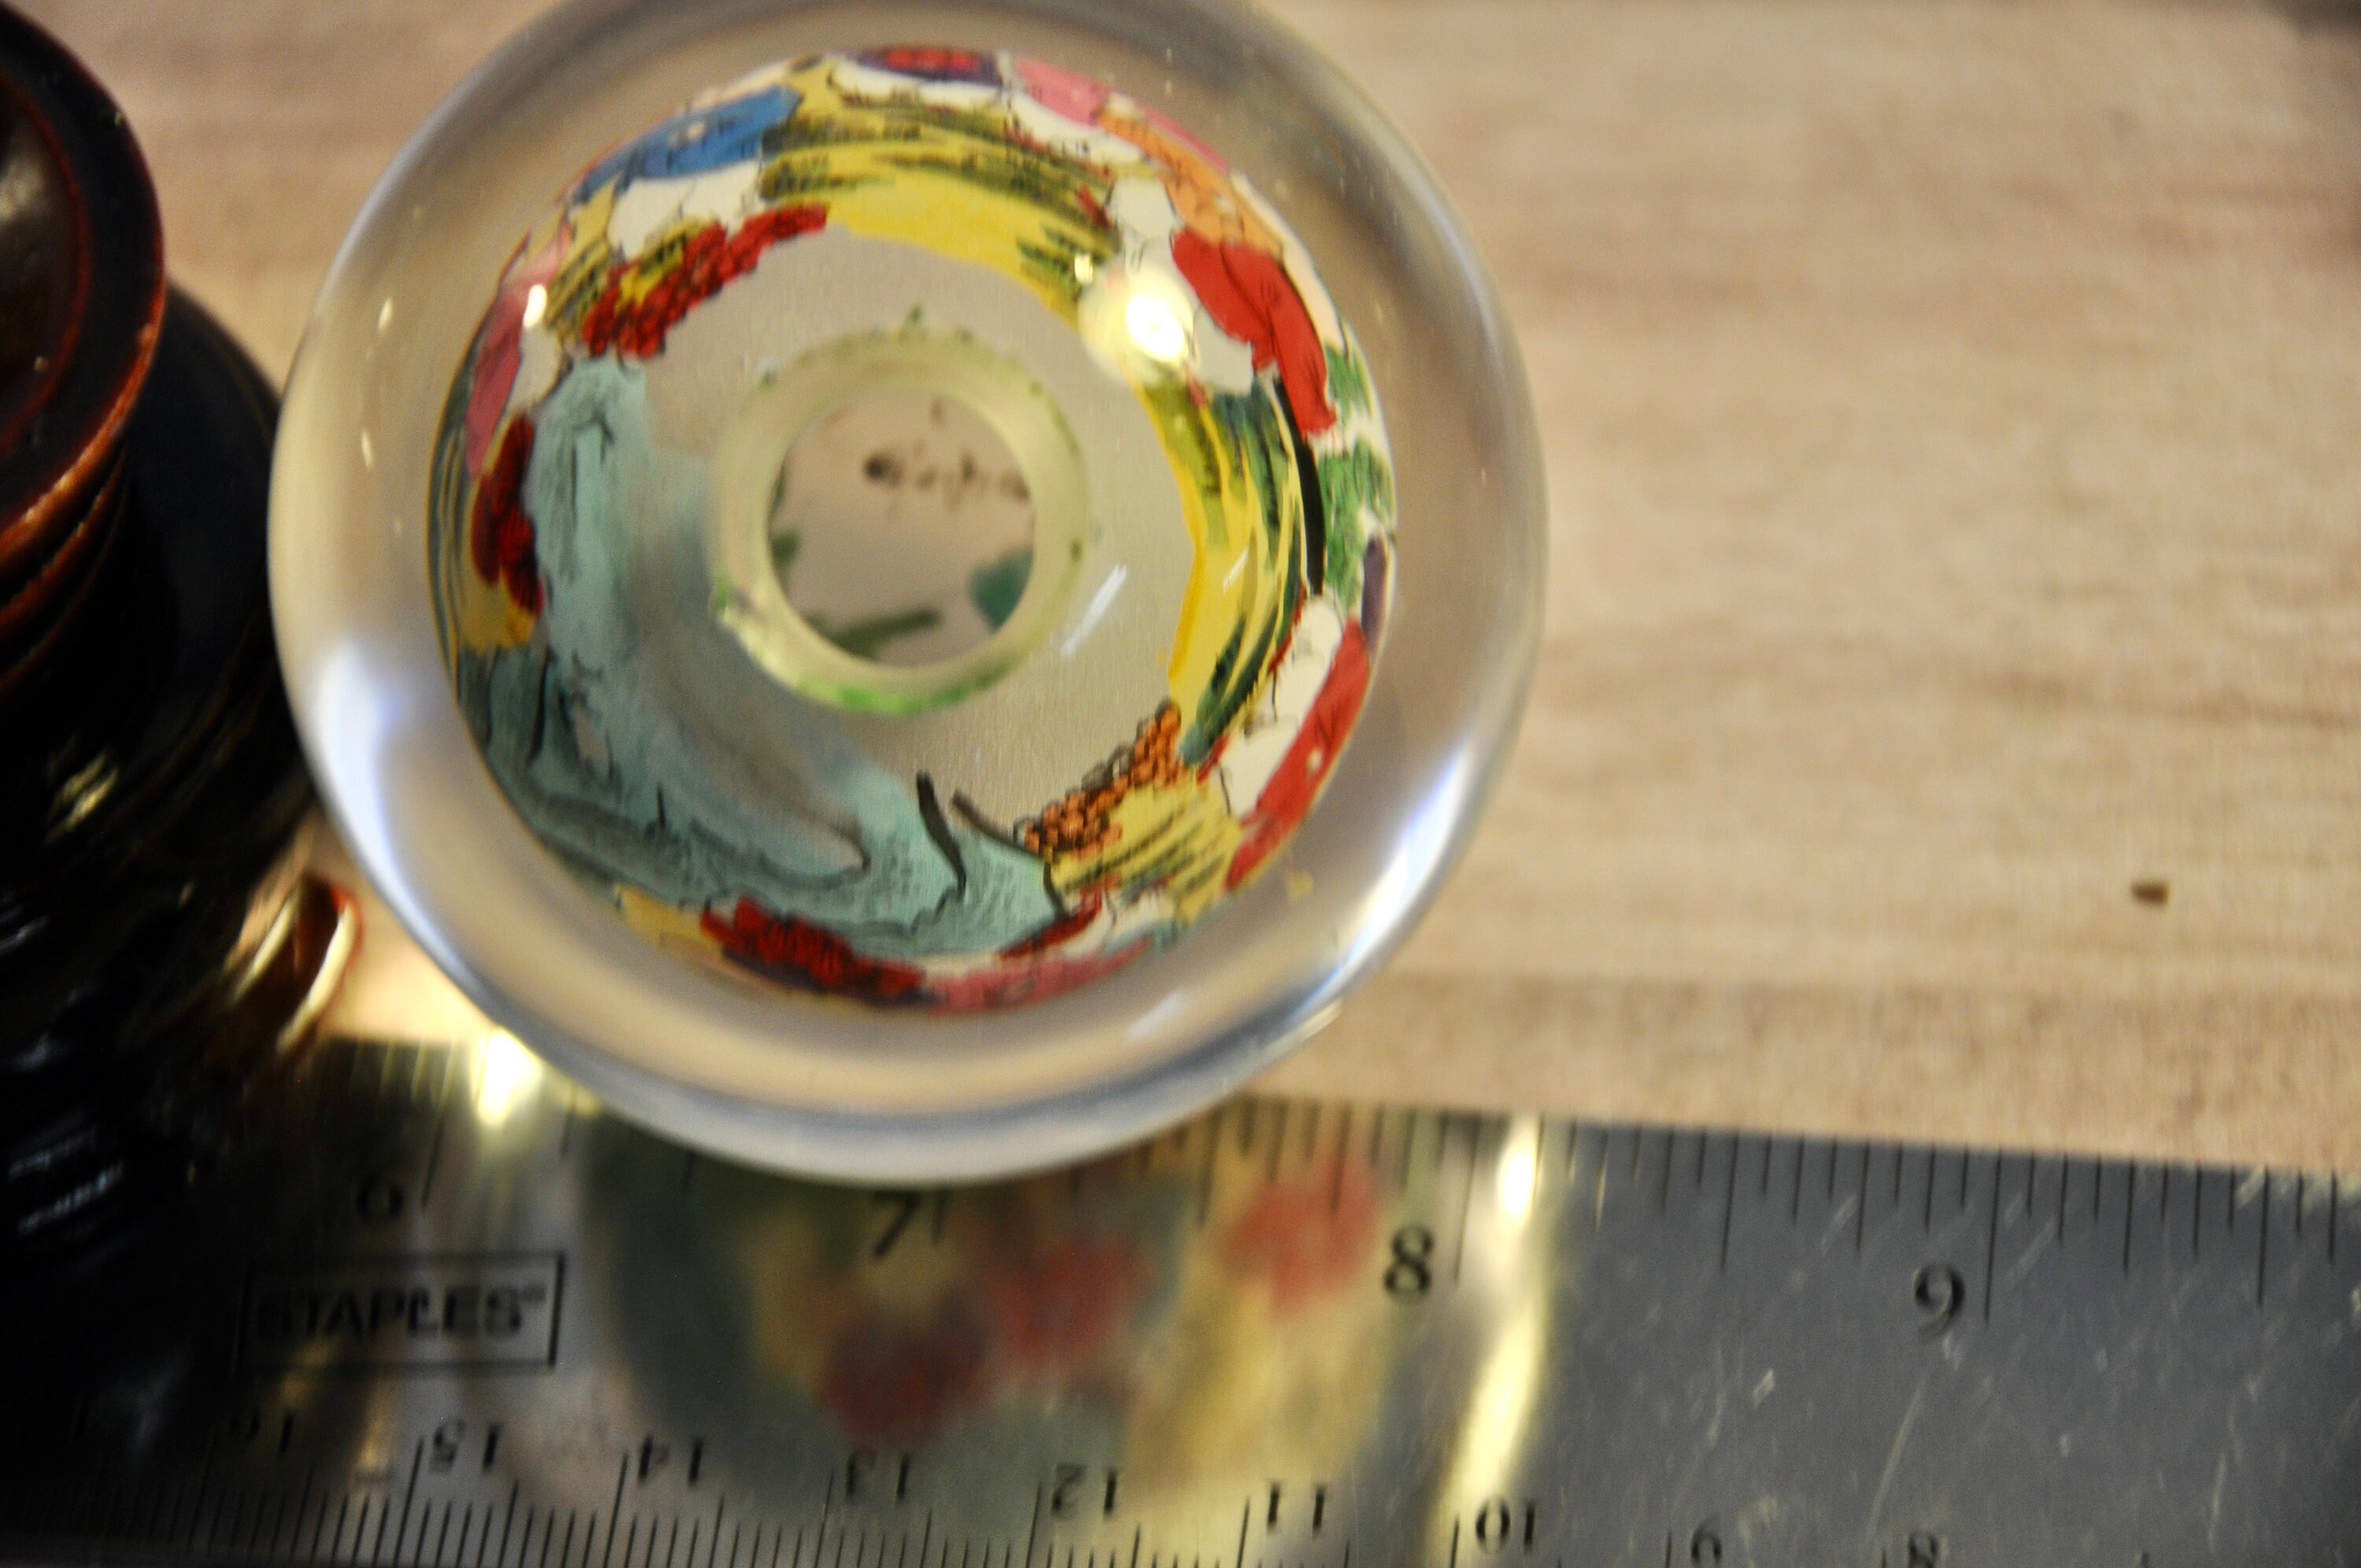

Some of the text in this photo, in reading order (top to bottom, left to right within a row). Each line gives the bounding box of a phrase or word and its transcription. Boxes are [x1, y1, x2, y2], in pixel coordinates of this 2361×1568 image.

[874, 1182, 922, 1258] 7
[1383, 1223, 1435, 1305] 8
[1912, 1263, 1966, 1337] 9
[428, 1417, 504, 1473] 15
[637, 1433, 708, 1488] 14
[845, 1445, 912, 1506] 13
[1051, 1462, 1118, 1520] 12
[1266, 1479, 1328, 1536] 11
[1474, 1495, 1537, 1552] 10
